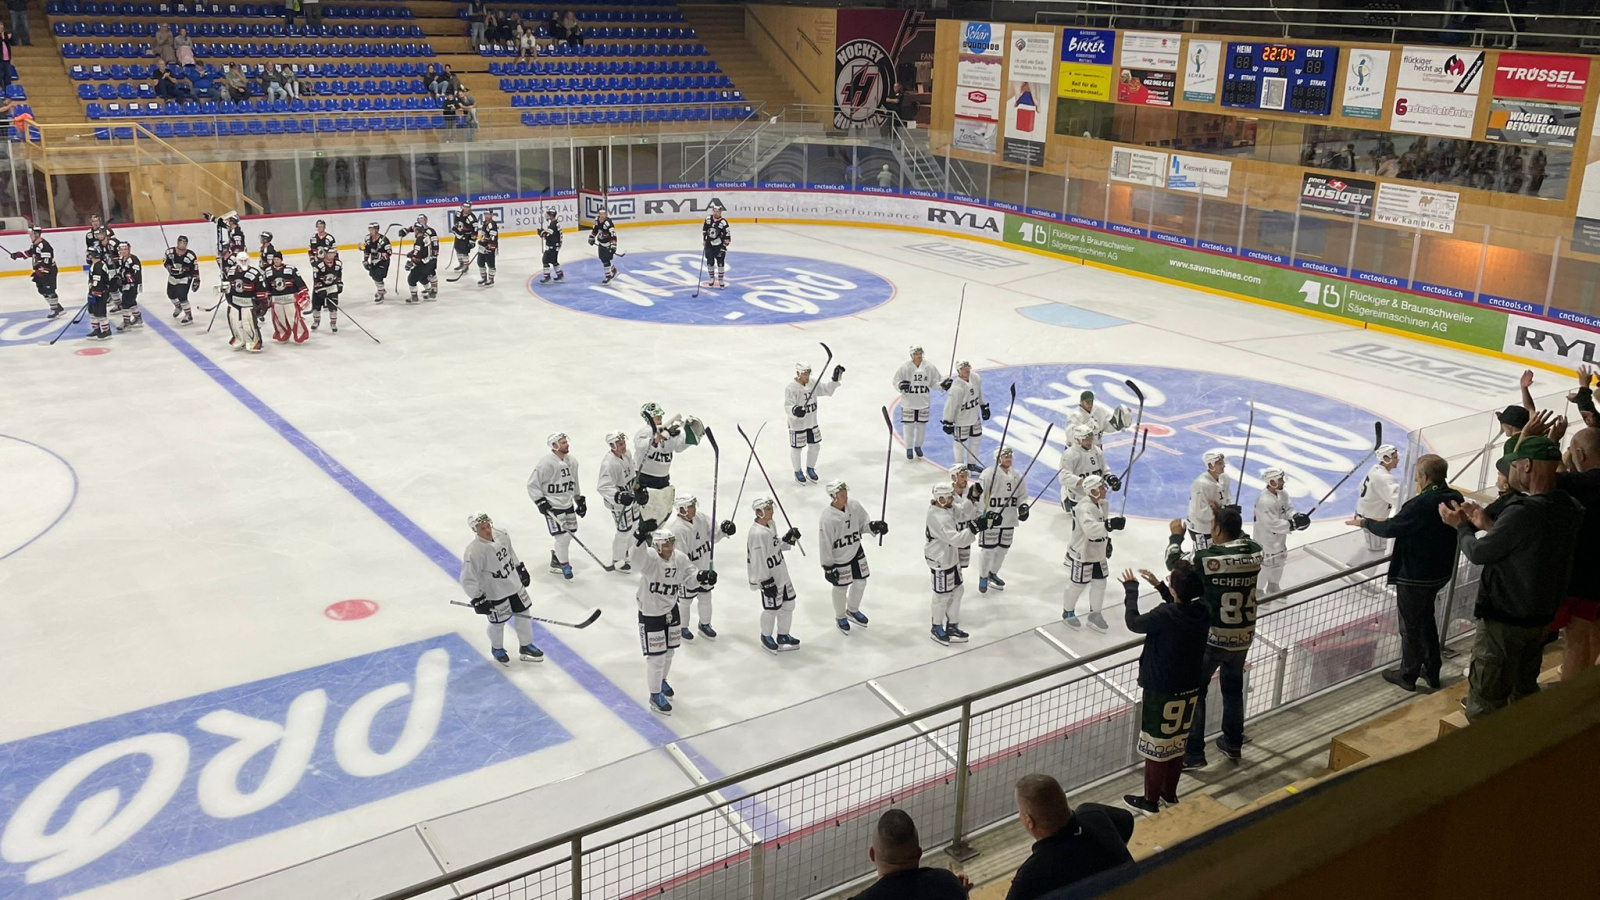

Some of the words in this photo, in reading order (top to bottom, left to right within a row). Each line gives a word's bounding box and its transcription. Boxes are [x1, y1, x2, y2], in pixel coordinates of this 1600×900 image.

[836, 43, 884, 66] HOCKEY
[1236, 45, 1252, 54] HEIM
[1262, 46, 1296, 61] 22:04
[1306, 49, 1324, 58] GAST
[1404, 56, 1432, 66] flückiger
[1414, 64, 1432, 74] hecht
[1434, 66, 1442, 74] ag
[1497, 66, 1586, 84] TRÜSSEL
[1506, 121, 1577, 136] BETONTECHNIK
[1183, 164, 1208, 174] Kieswerk
[954, 195, 979, 204] cnctools.ch
[1303, 184, 1372, 205] bösiger
[994, 202, 1018, 211] cnctools.ch
[516, 211, 579, 226] SOLUONS
[644, 198, 727, 214] RYLA
[734, 204, 818, 213] Immobilien
[825, 205, 919, 220] Performance
[928, 207, 999, 233] RYLA
[1032, 209, 1056, 218] cnctools.ch
[1071, 216, 1097, 226] cnctools.ch
[1378, 214, 1451, 230] www.kamele.ch
[1113, 224, 1140, 235] cnctools.ch
[1053, 229, 1080, 242] Flückiger
[1087, 236, 1135, 253] Braunschweiler
[1157, 233, 1187, 244] cnctools.ch
[1052, 240, 1106, 258] Sägereimaschinen
[1107, 252, 1118, 260] AG
[1202, 242, 1232, 253] cnctools.ch
[1249, 251, 1281, 263] cnctools.ch
[1169, 259, 1261, 285] www.sawmachines.com
[1302, 261, 1338, 273] cnctools.ch
[1360, 272, 1398, 285] cnctools.ch
[1422, 284, 1463, 298] cnctools.ch
[1350, 290, 1389, 307] Flückiger
[1392, 299, 1398, 308] &
[1401, 301, 1474, 324] Braunschweiler
[1489, 298, 1533, 312] cnctools.ch
[1347, 303, 1429, 328] Sägereimaschinen
[1432, 322, 1448, 332] AG
[1515, 325, 1600, 366] RYL
[561, 467, 570, 478] 31
[548, 481, 574, 494] OLTE
[1007, 483, 1011, 491] 3
[845, 520, 850, 528] 7
[496, 547, 507, 561] 22
[665, 568, 676, 578] 27
[1161, 696, 1198, 734] 91
